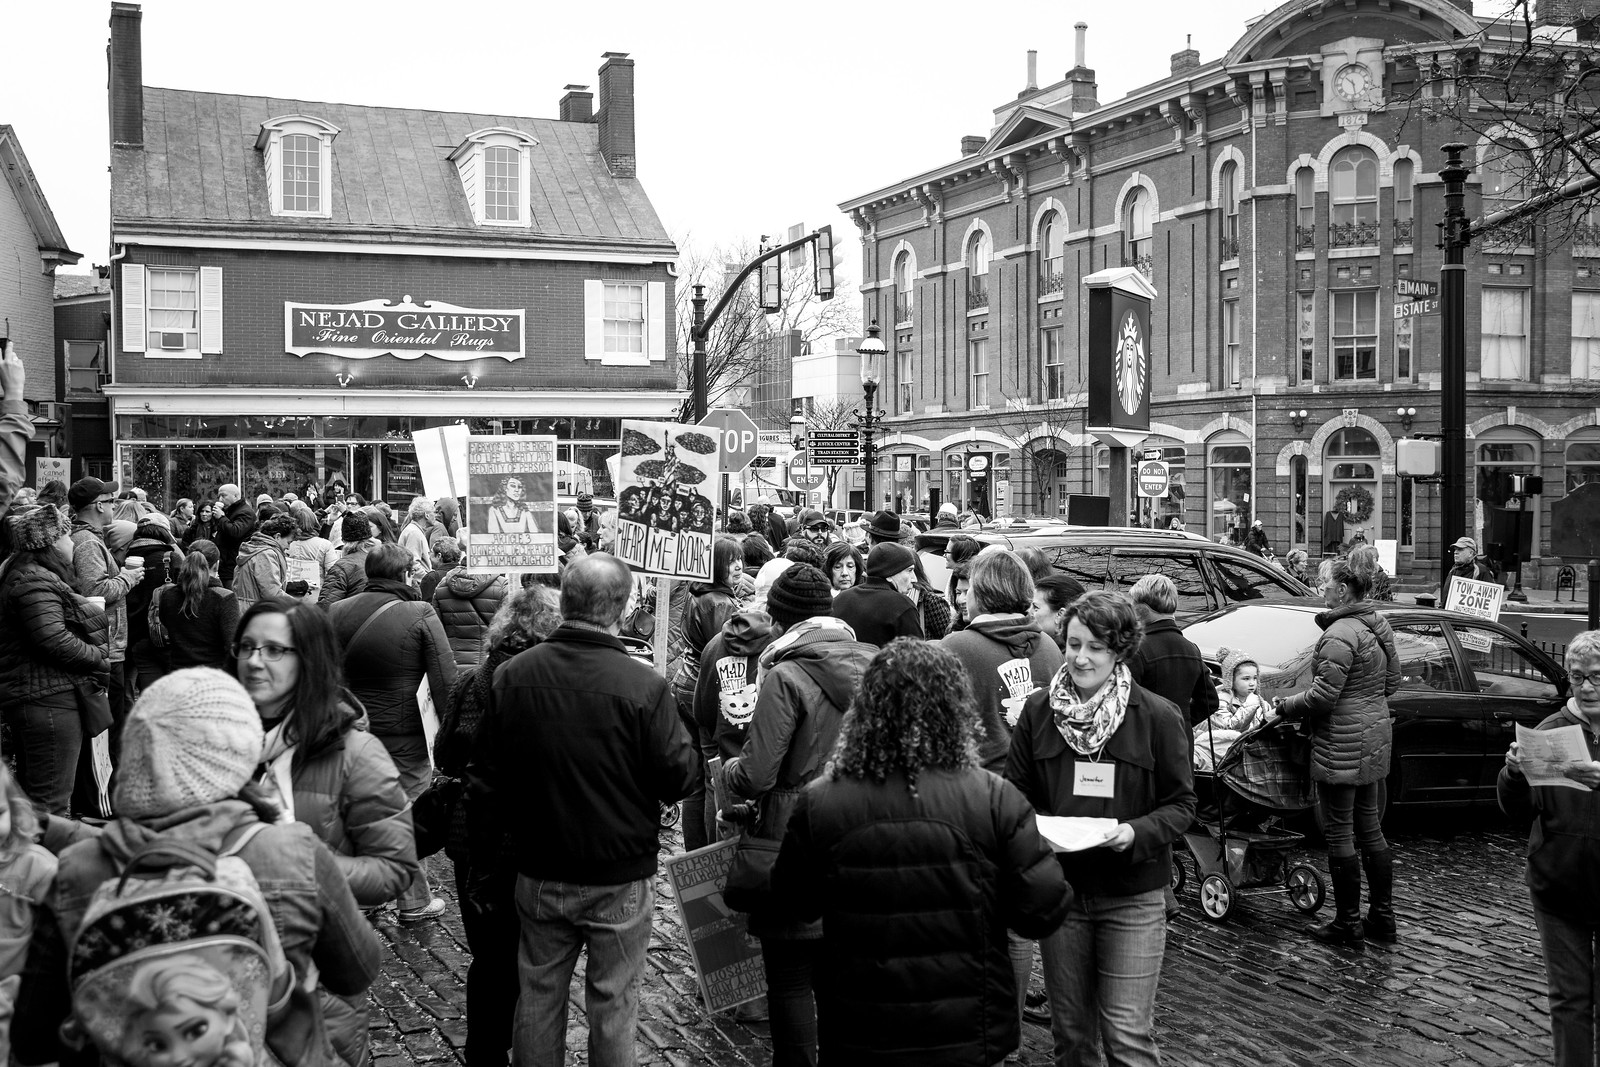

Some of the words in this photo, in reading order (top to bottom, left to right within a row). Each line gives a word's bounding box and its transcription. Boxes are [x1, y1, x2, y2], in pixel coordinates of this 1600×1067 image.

[1407, 281, 1429, 296] MAIN
[1403, 300, 1430, 316] STATE
[300, 311, 385, 328] NEJAD
[397, 314, 514, 332] GALLERY
[314, 328, 358, 343] Fine
[371, 329, 442, 345] Oriental
[451, 332, 495, 350] Rugs
[517, 442, 530, 452] THE
[532, 441, 552, 451] RIGHT
[471, 453, 482, 463] TO
[504, 452, 533, 462] LIBERTY
[793, 458, 803, 466] DO
[470, 464, 505, 474] SECURITY
[507, 463, 517, 473] OF
[796, 476, 819, 484] ENER
[1144, 483, 1163, 491] ENTER
[491, 533, 523, 544] ARTICLE
[524, 533, 532, 544] 3
[620, 522, 645, 563] HEAR
[648, 534, 674, 571] ME
[678, 534, 708, 575] ROAR
[471, 556, 482, 566] OF
[521, 555, 552, 565] RIGHTS
[1458, 594, 1491, 610] ZONE
[719, 662, 746, 681] MAD
[1003, 666, 1030, 686] MAD
[675, 849, 727, 875] RIGHTS
[676, 859, 736, 889] CLARATION
[707, 958, 757, 984] PERSON
[711, 987, 744, 1008] RIGHT
